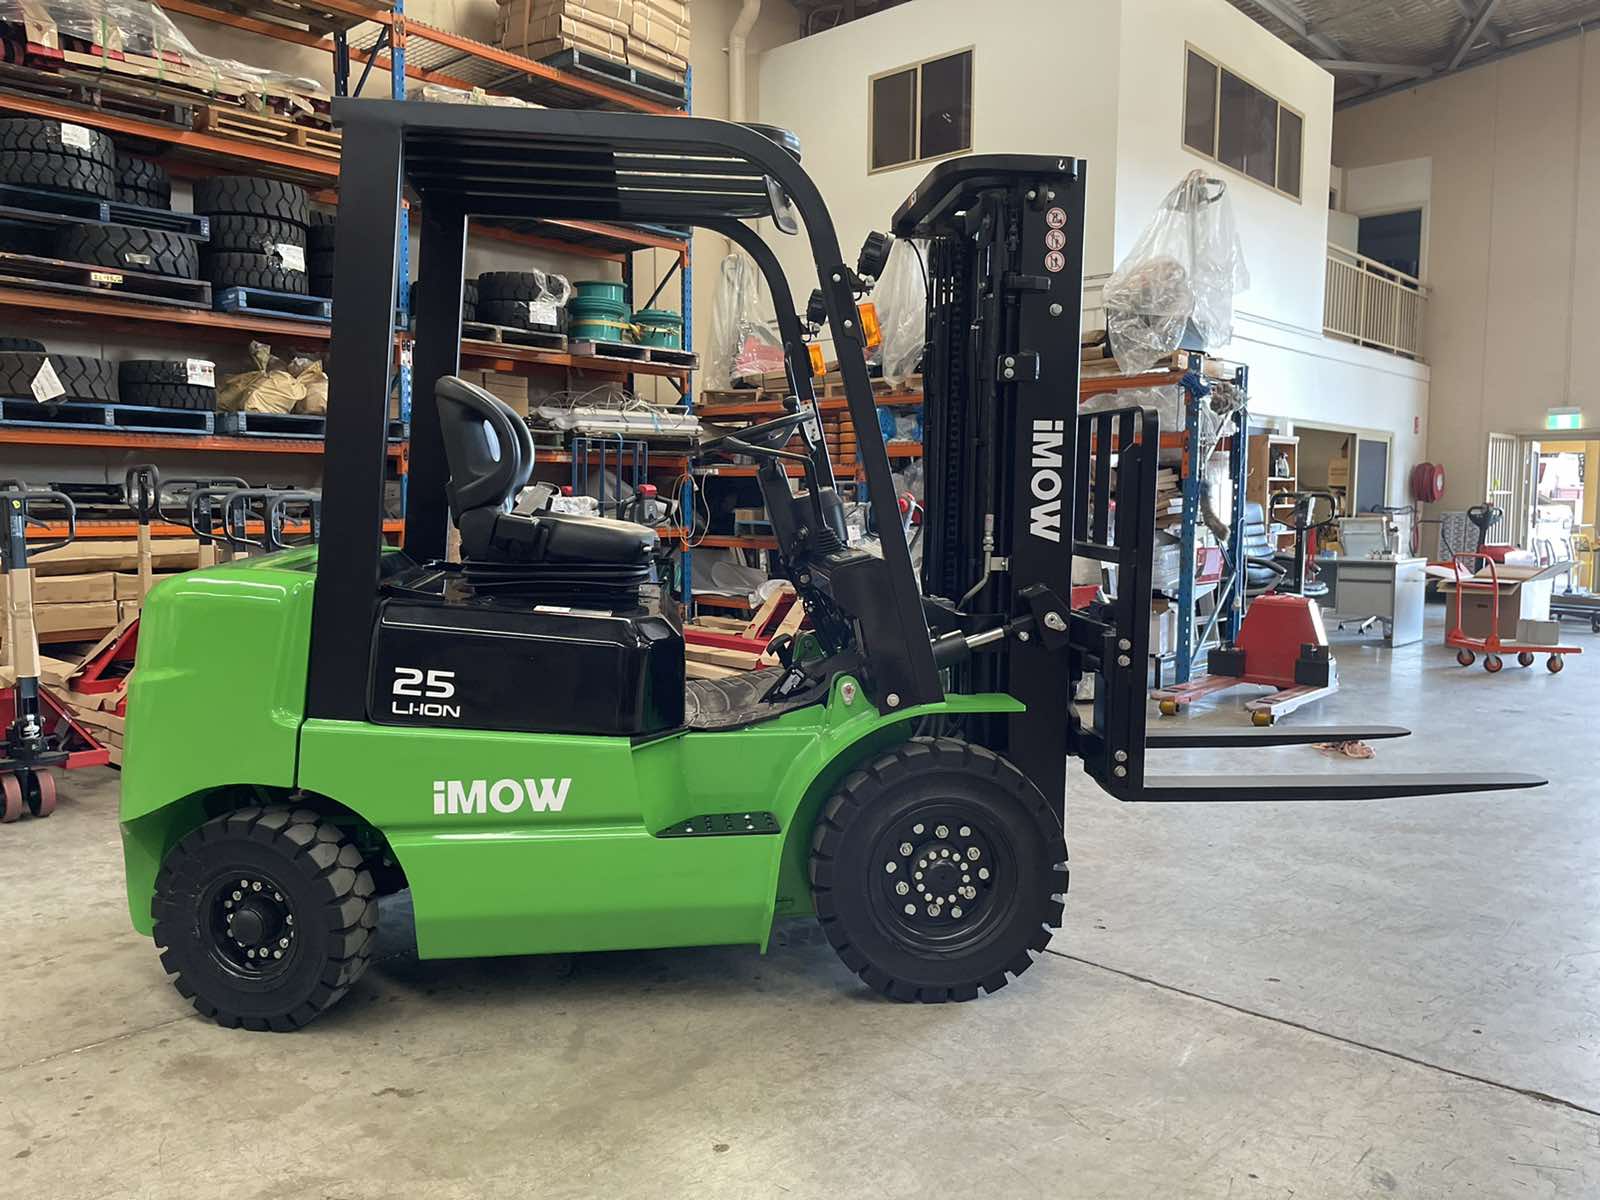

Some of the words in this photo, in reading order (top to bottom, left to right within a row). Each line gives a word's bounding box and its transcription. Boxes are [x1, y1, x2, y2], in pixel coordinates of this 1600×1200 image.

[1030, 420, 1064, 543] iMOW
[392, 667, 455, 699] 25
[392, 701, 461, 718] LI-ION
[433, 778, 572, 815] iMOW
